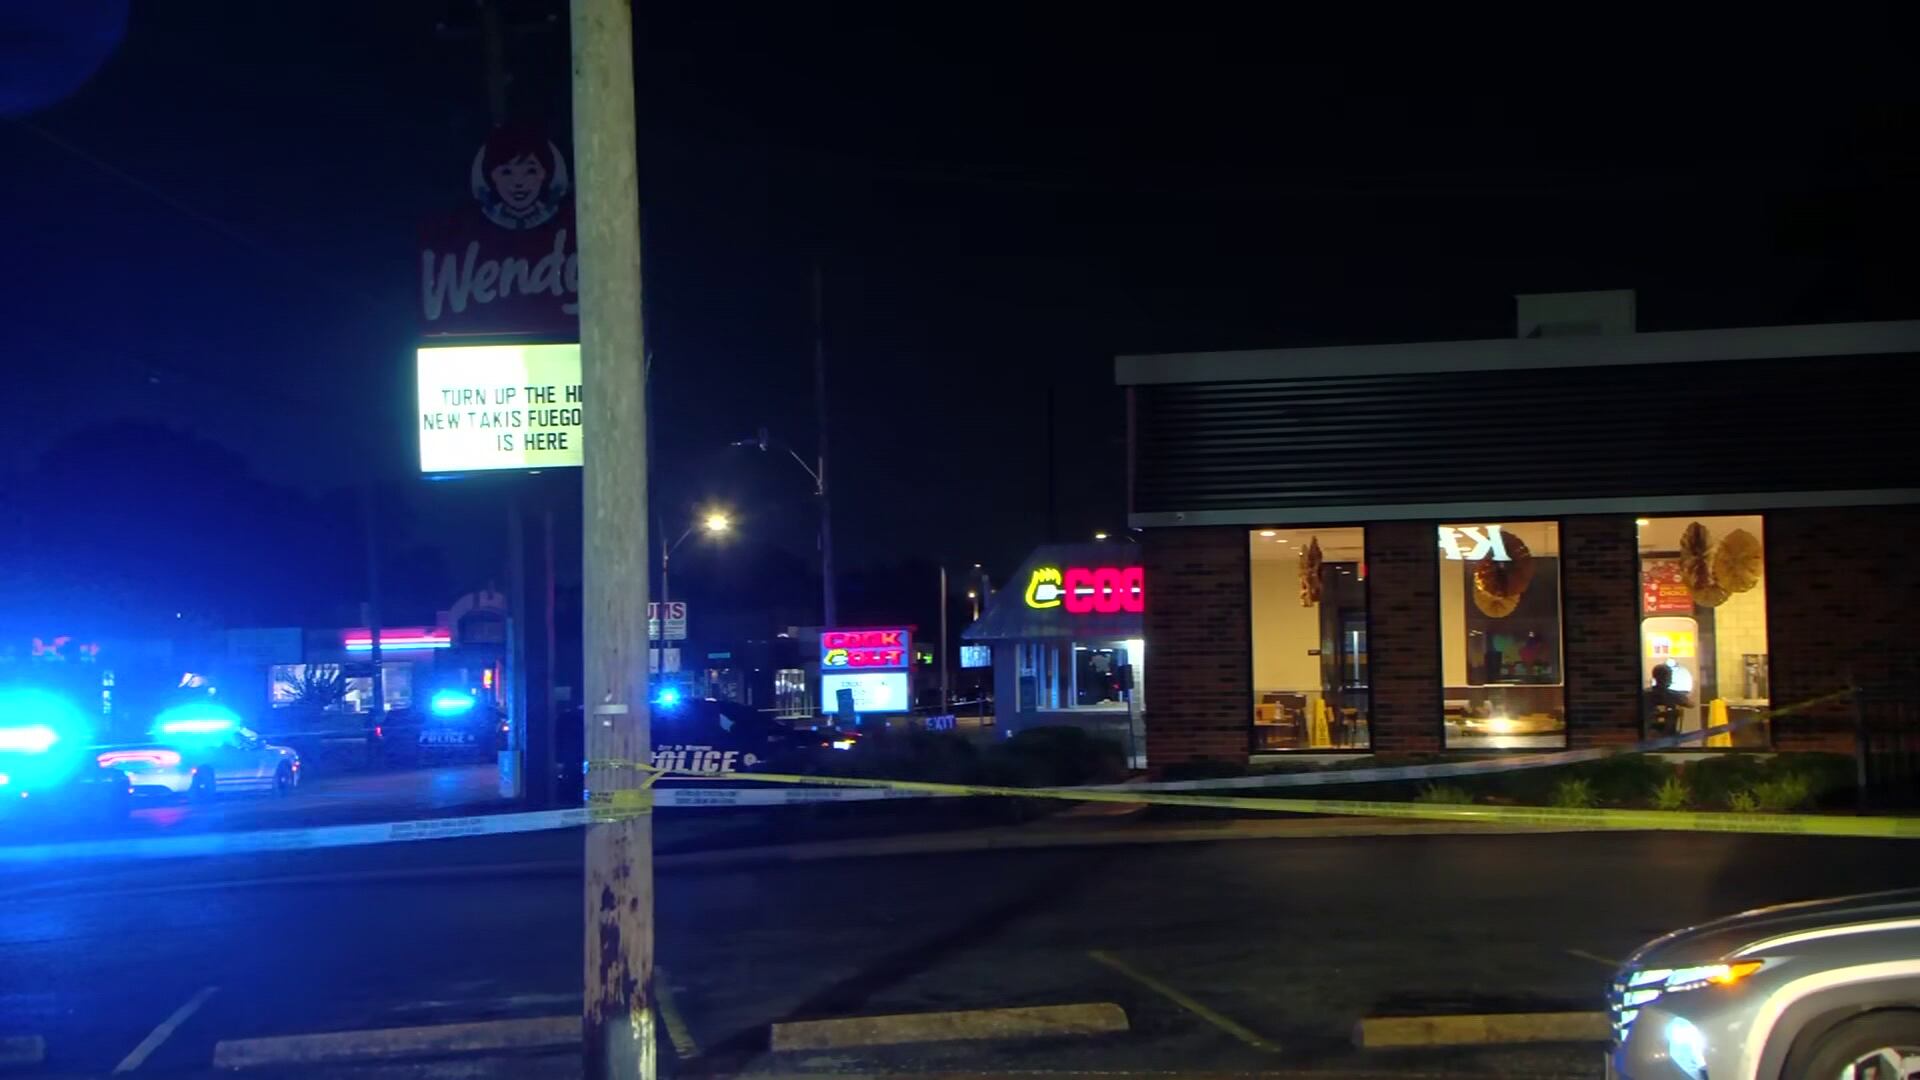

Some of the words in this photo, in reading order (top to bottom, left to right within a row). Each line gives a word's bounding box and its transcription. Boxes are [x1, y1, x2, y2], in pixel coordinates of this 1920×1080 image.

[442, 388, 487, 406] TURN
[495, 387, 517, 405] UP
[524, 385, 556, 404] THE
[423, 413, 461, 430] NEW
[468, 411, 522, 429] TAKIS
[528, 409, 582, 427] FUEGO
[497, 434, 514, 451] IS
[524, 433, 568, 451] HERE
[824, 631, 903, 649] COOK
[848, 650, 904, 667] OUT
[927, 715, 955, 731] EXIT
[650, 751, 740, 774] OLICE
